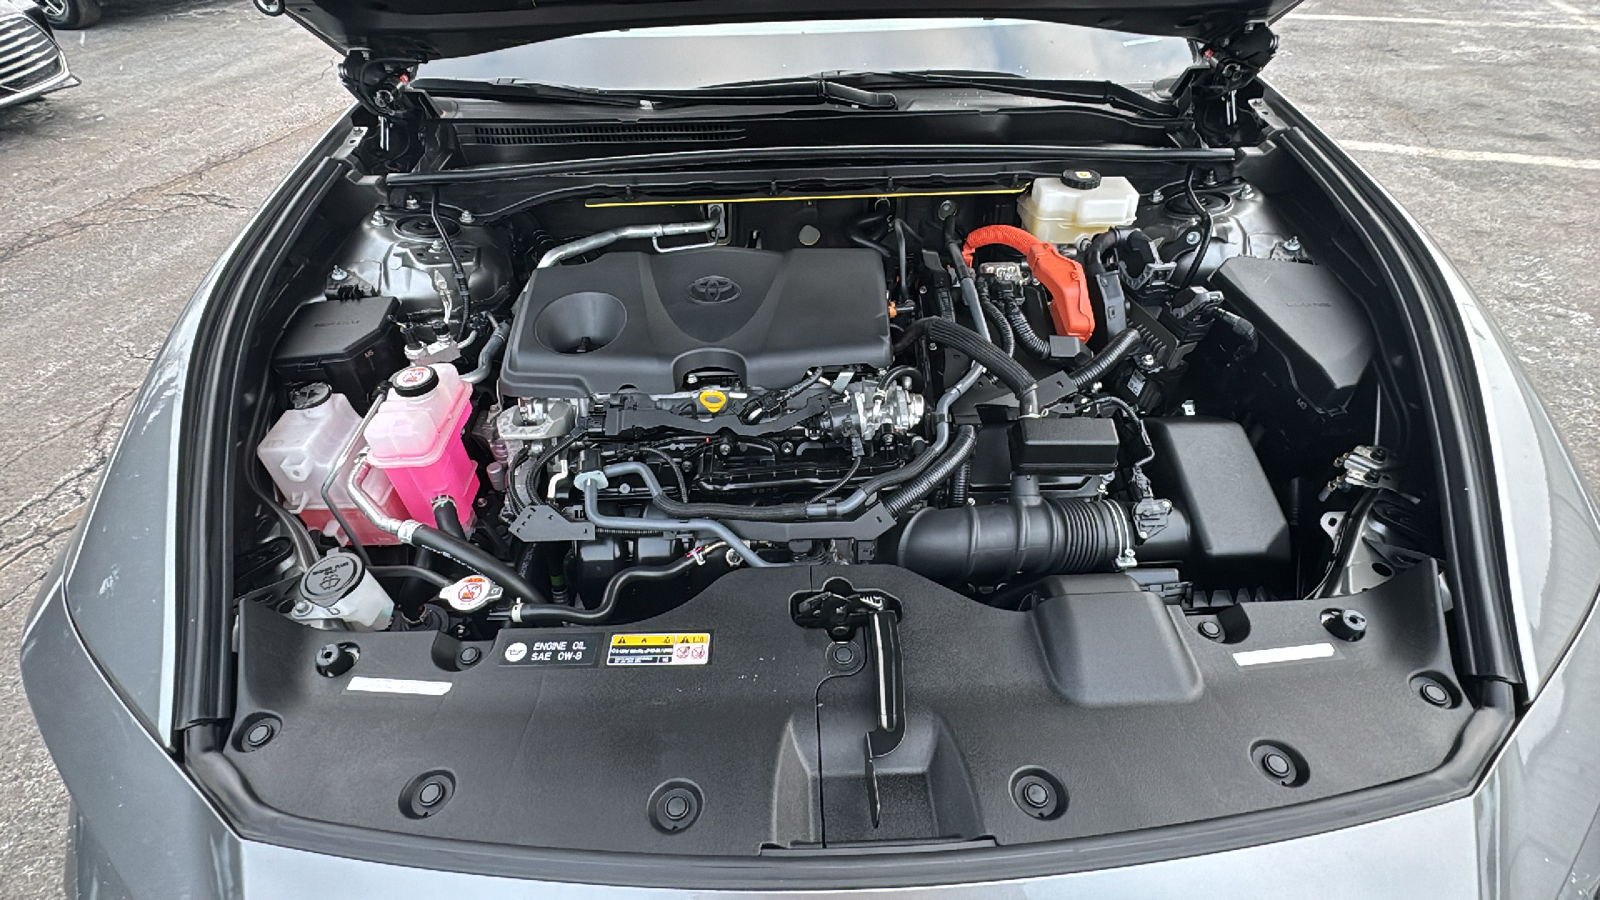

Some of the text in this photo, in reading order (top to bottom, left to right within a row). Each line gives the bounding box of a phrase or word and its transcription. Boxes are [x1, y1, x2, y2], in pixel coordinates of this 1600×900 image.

[533, 641, 587, 651] ENGINE OIL
[531, 651, 583, 661] SAE 0W-8
